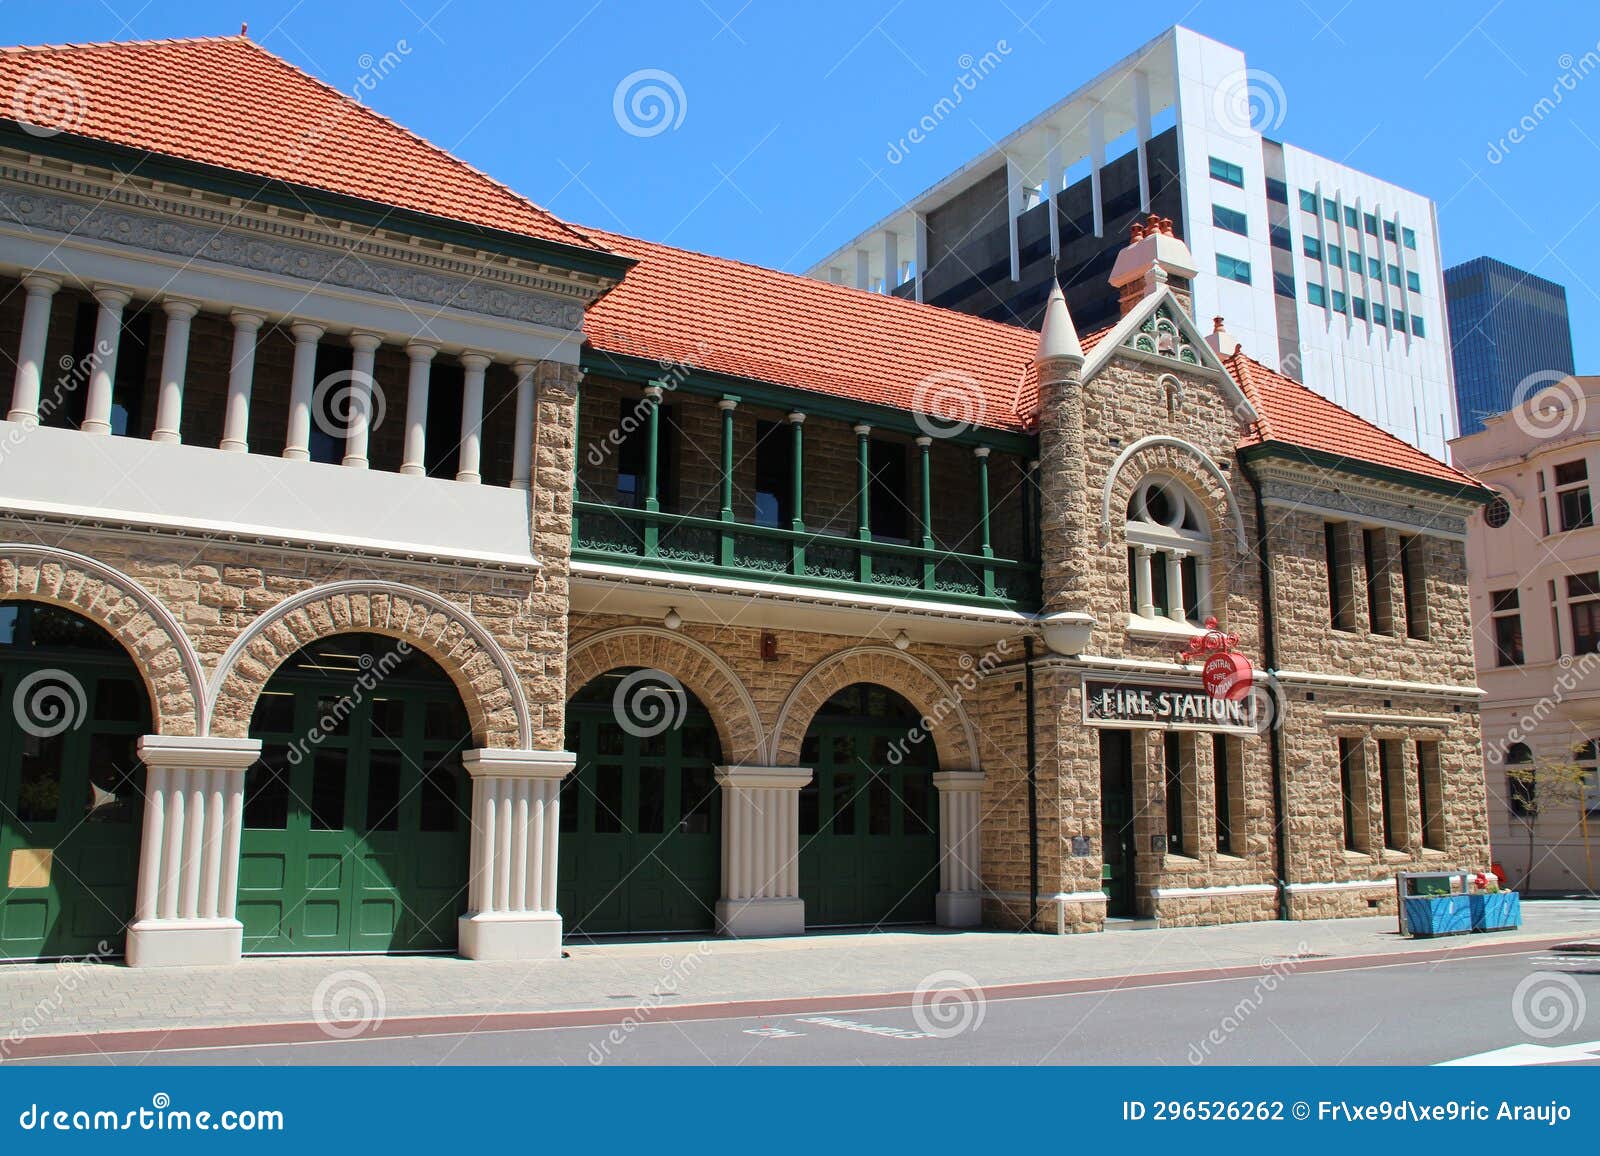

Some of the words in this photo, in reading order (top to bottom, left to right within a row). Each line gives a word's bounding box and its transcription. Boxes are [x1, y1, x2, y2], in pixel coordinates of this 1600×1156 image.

[1205, 659, 1233, 673] CENTRAL
[1213, 672, 1227, 680] FIRE
[1206, 679, 1233, 695] STATION
[1102, 688, 1154, 716] FIRE
[1158, 691, 1240, 721] STATION
